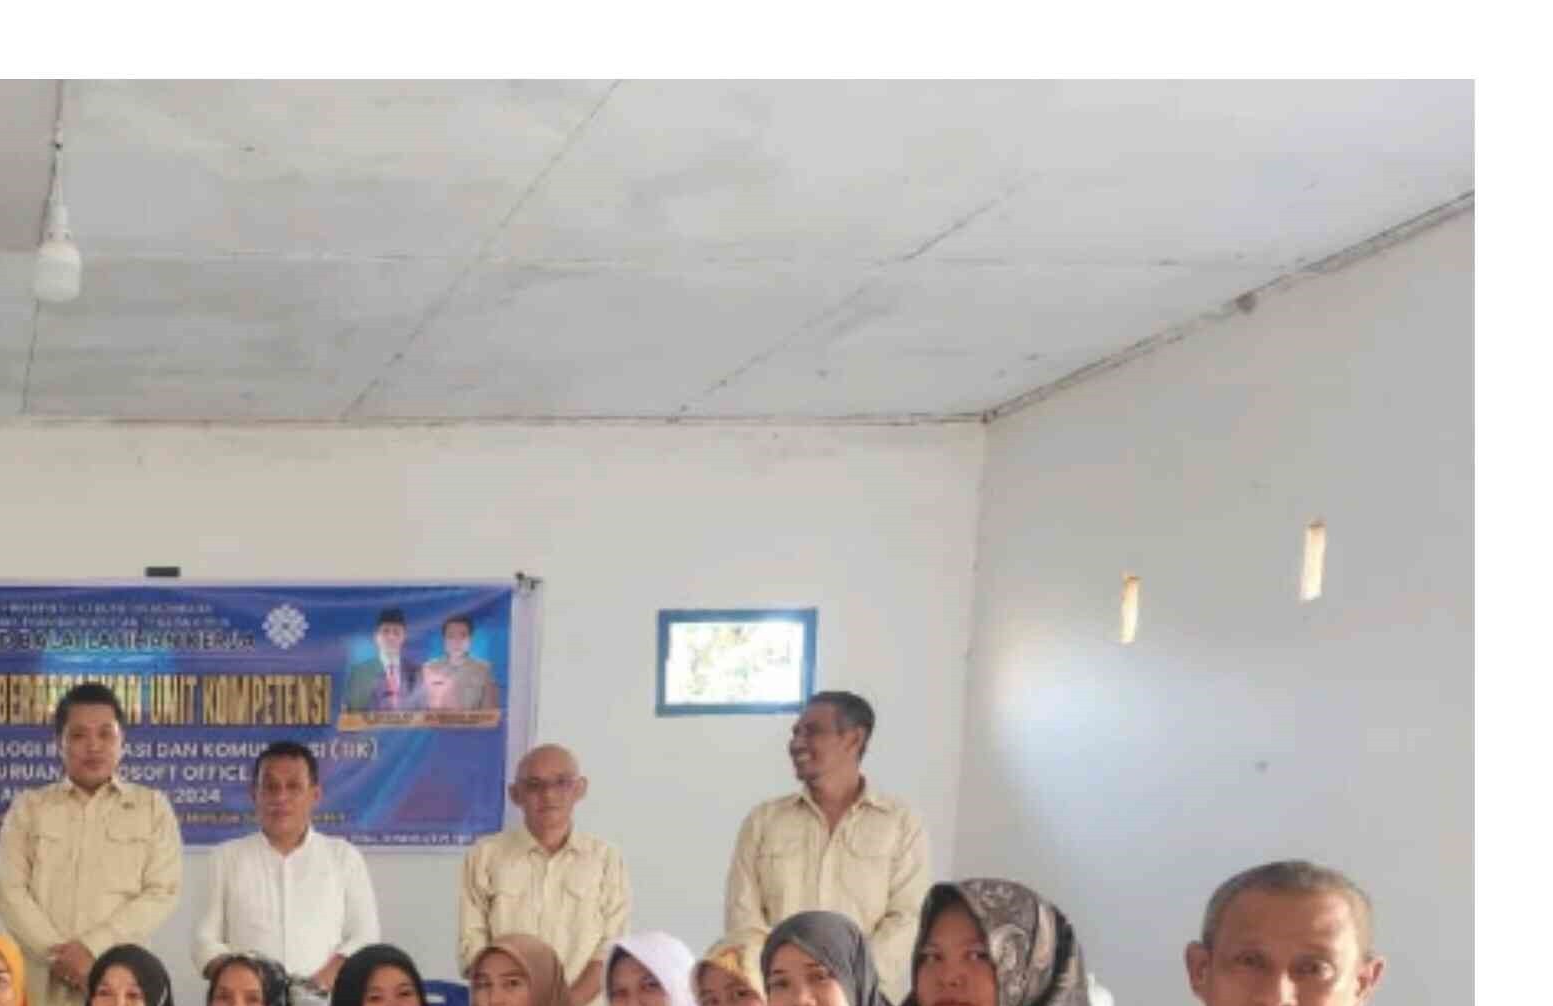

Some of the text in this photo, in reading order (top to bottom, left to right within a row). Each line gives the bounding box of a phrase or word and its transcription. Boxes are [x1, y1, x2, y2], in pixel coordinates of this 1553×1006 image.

[149, 674, 197, 725] UNIT
[202, 674, 333, 725] KOMPETENSI
[157, 742, 197, 757] DAN
[174, 788, 222, 803] 2024
